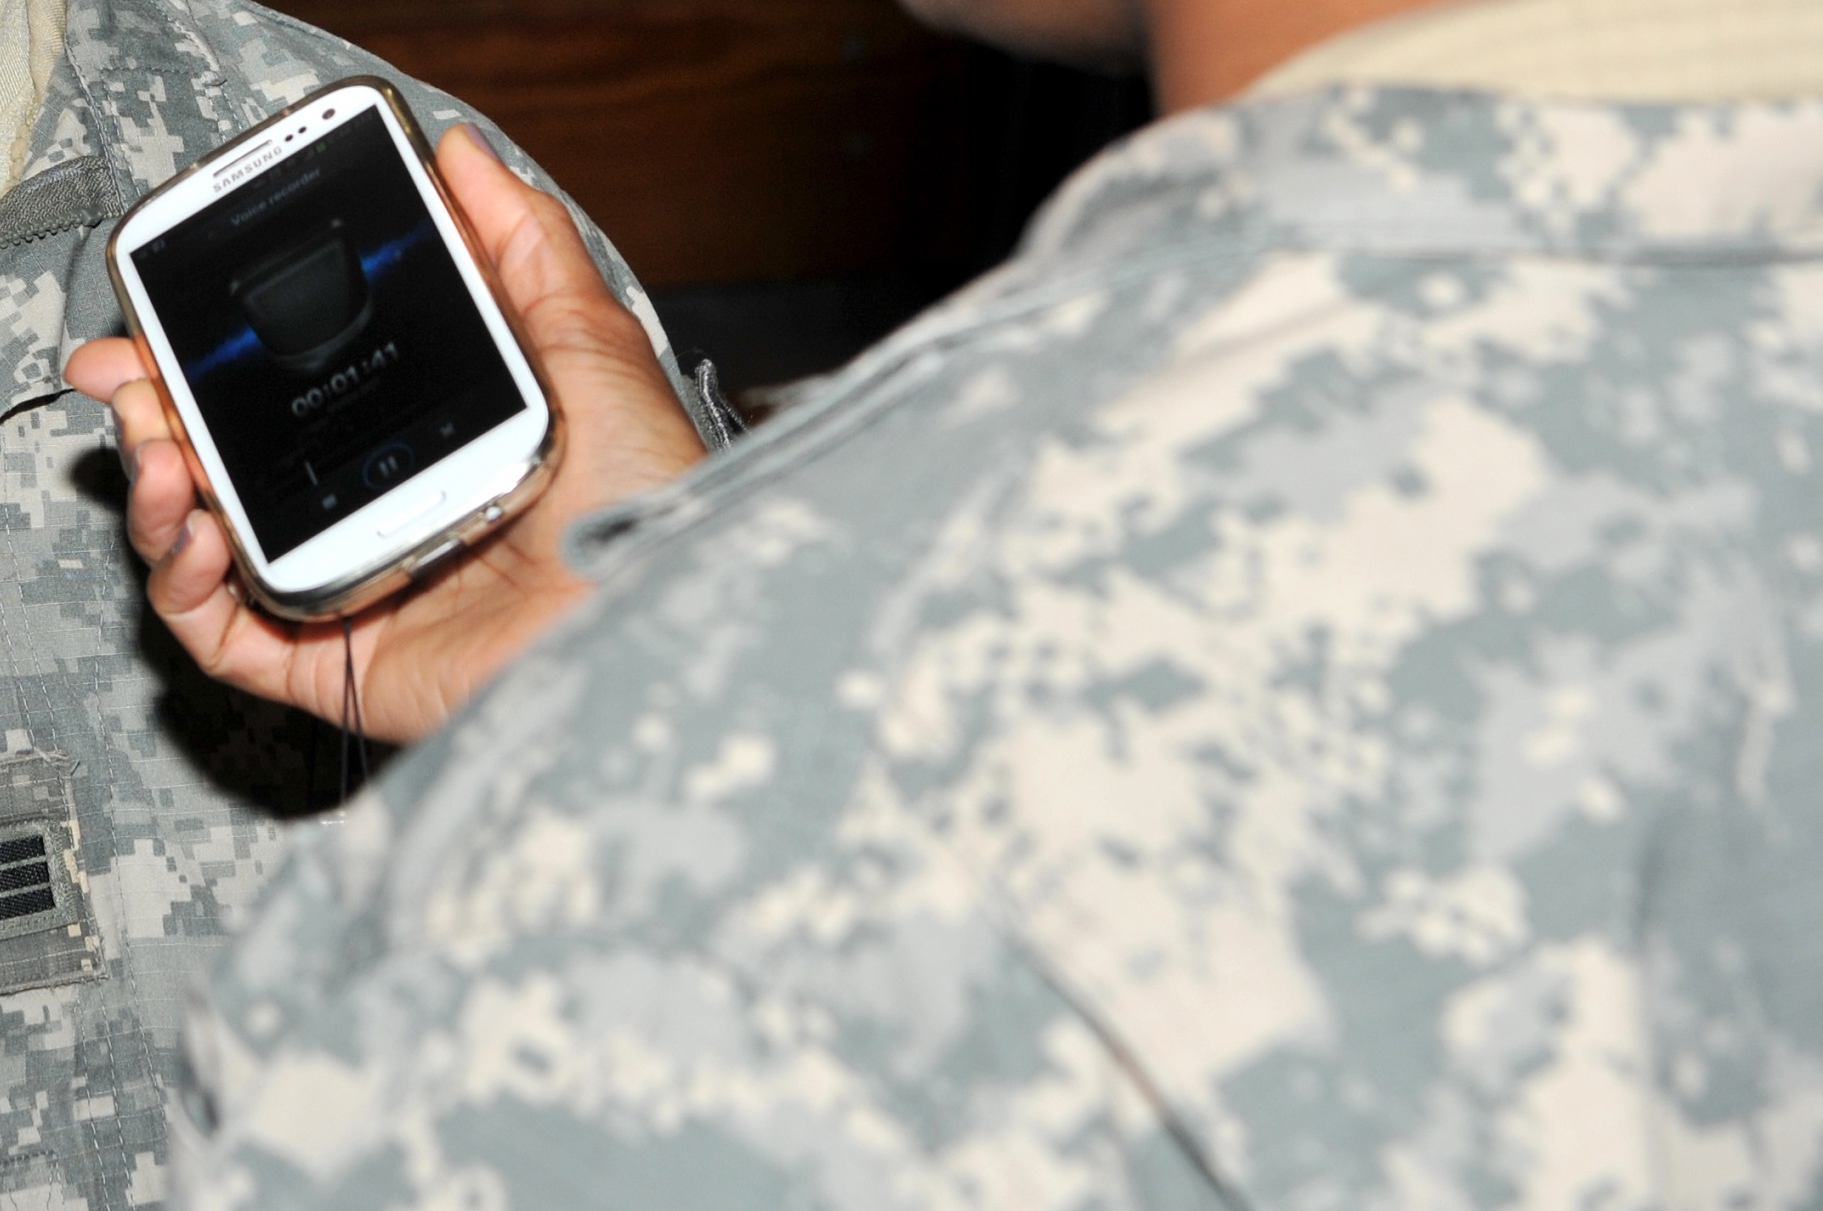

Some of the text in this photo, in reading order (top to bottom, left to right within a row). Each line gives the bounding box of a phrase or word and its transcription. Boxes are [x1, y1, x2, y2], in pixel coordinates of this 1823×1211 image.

[212, 145, 283, 193] SAMSUNG
[231, 168, 321, 227] Voice recorder
[291, 342, 398, 418] 00:01:41
